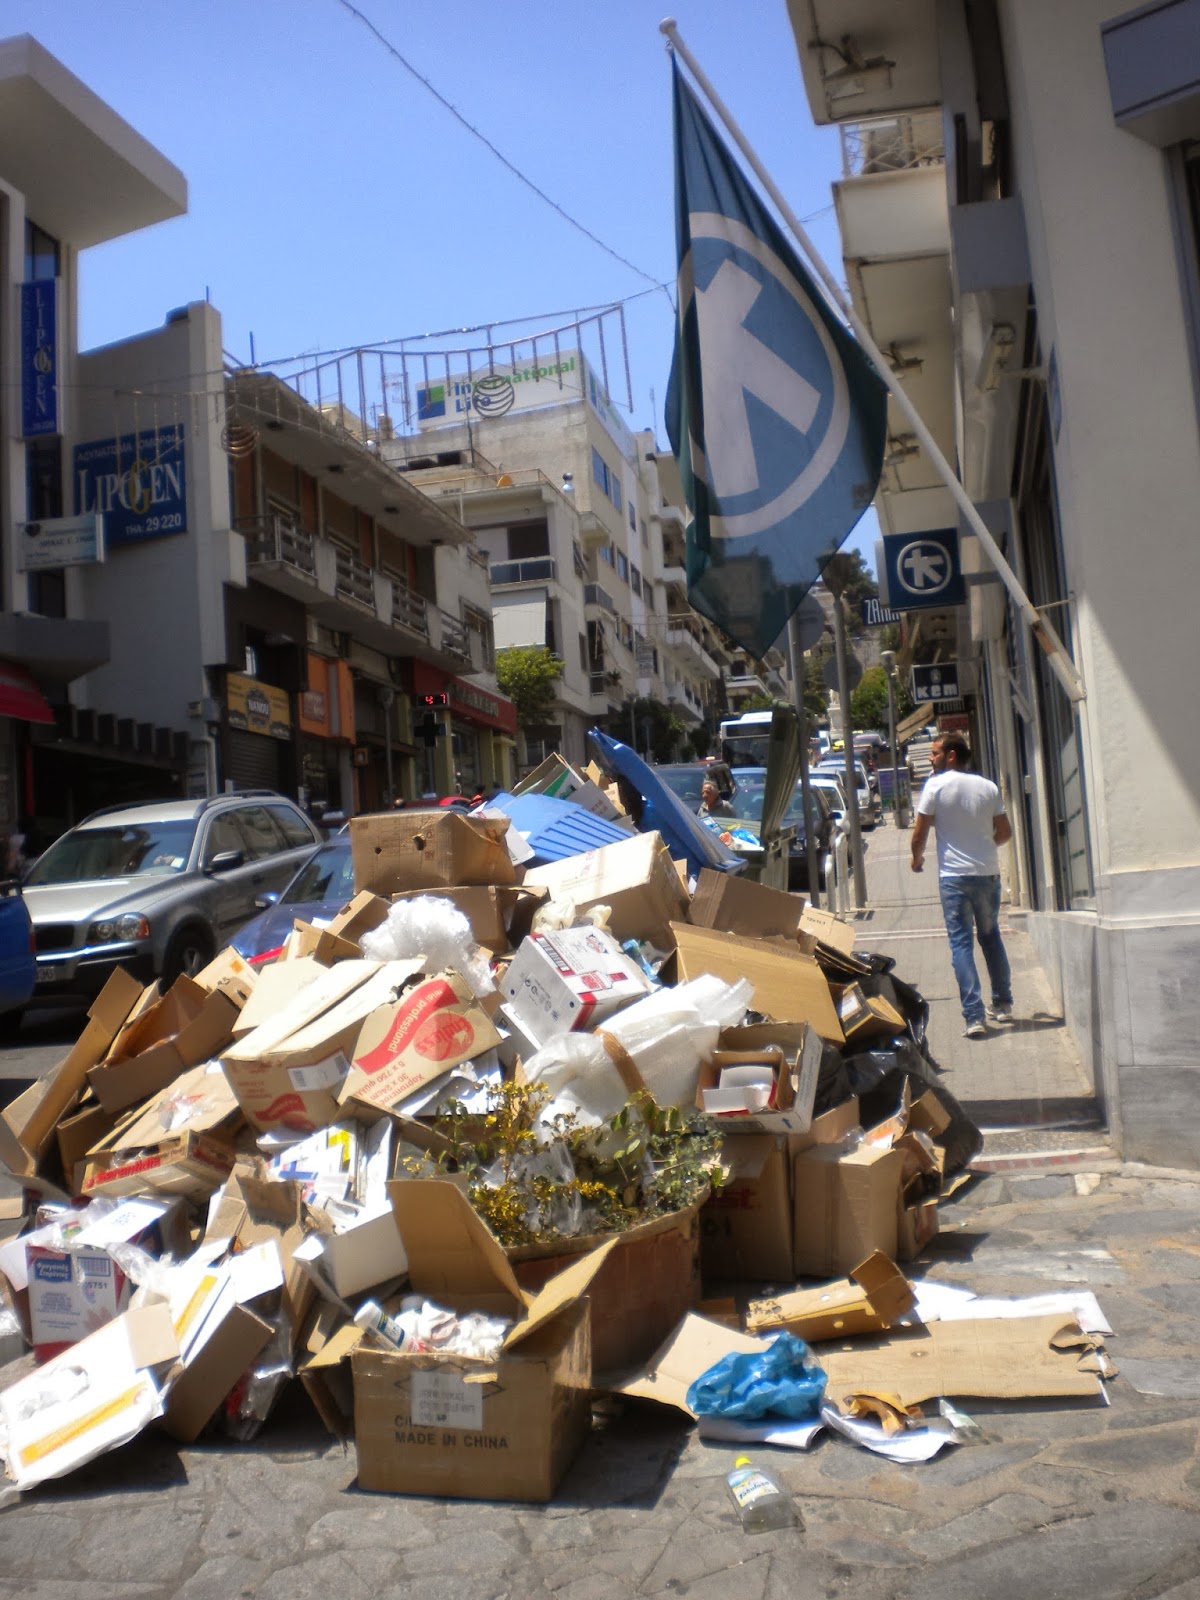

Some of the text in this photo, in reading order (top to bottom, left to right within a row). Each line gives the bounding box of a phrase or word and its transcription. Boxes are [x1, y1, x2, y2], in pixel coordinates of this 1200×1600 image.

[78, 457, 182, 515] LIPOGEN
[161, 512, 182, 529] 220
[387, 1000, 426, 1053] professional
[394, 1431, 509, 1449] MADE IN CHINA
